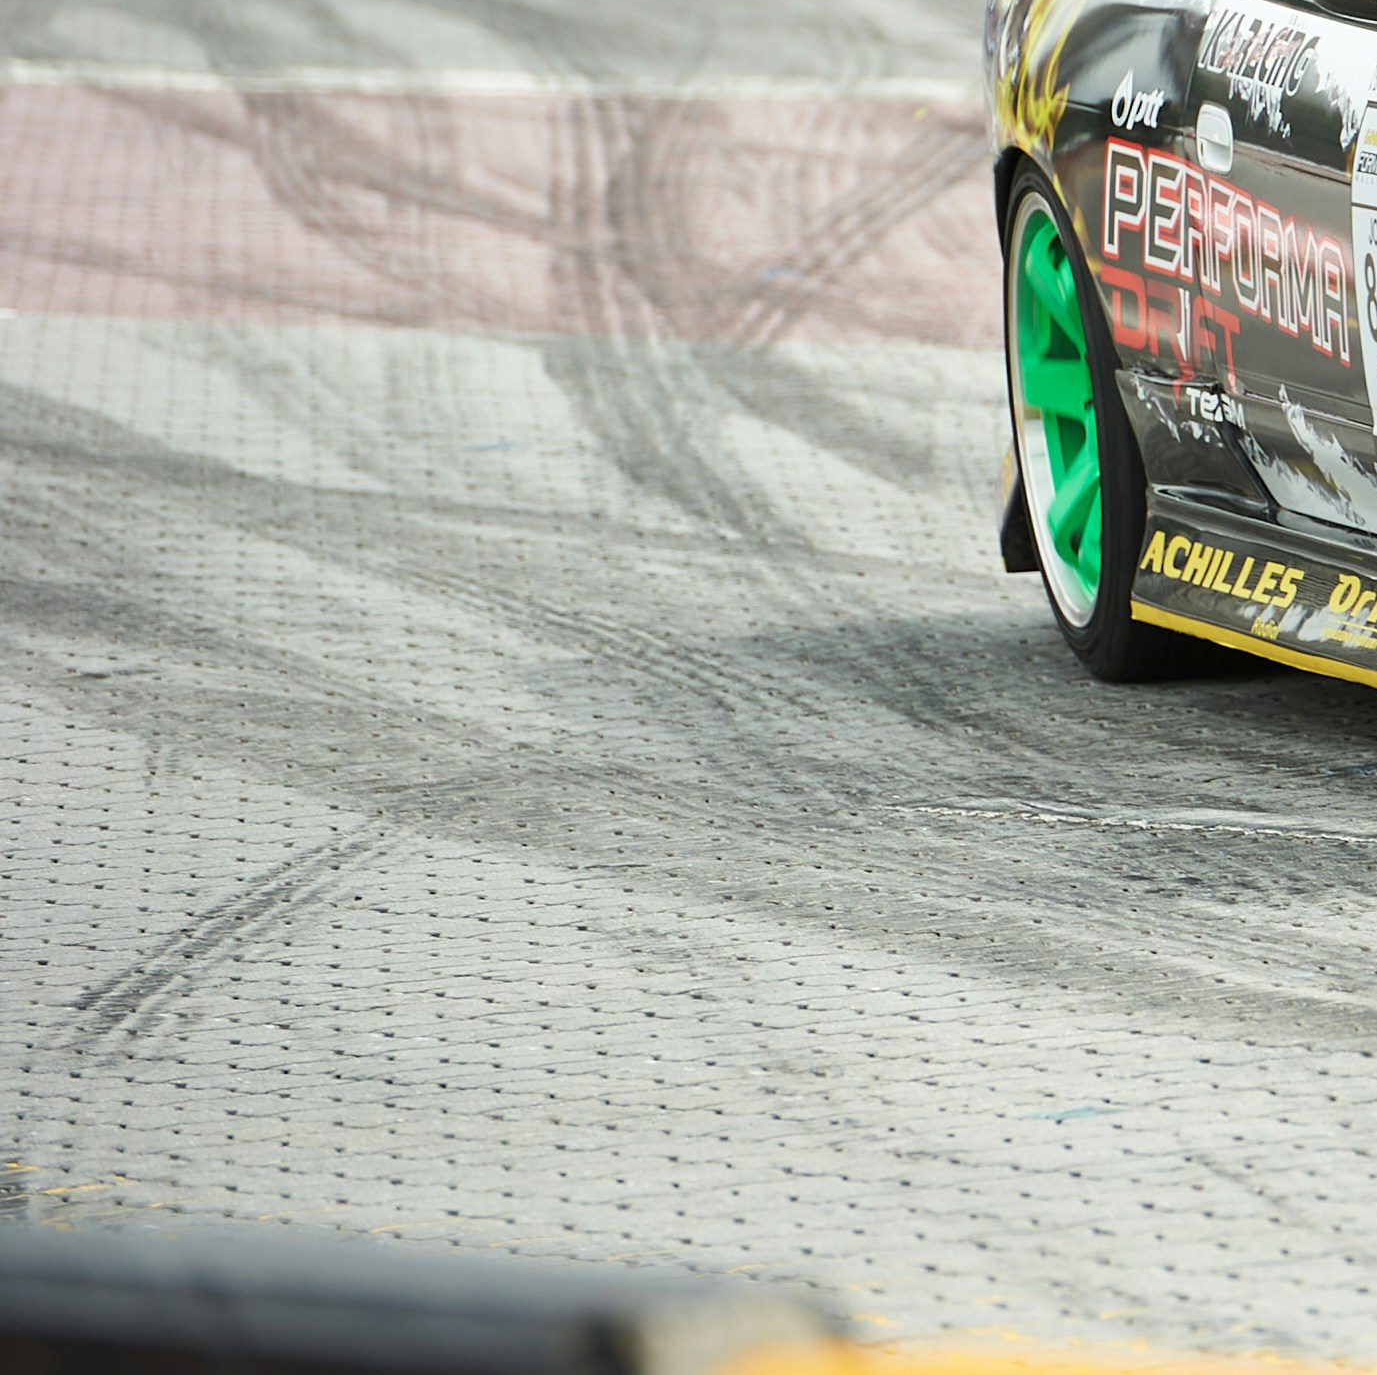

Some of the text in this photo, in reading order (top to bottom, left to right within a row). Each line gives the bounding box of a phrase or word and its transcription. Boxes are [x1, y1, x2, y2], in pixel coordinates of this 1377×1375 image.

[1127, 78, 1166, 129] ptt
[1101, 135, 1352, 368] PERFORMA
[1100, 263, 1241, 395] DRIFT
[1139, 529, 1306, 610] ACHILLES
